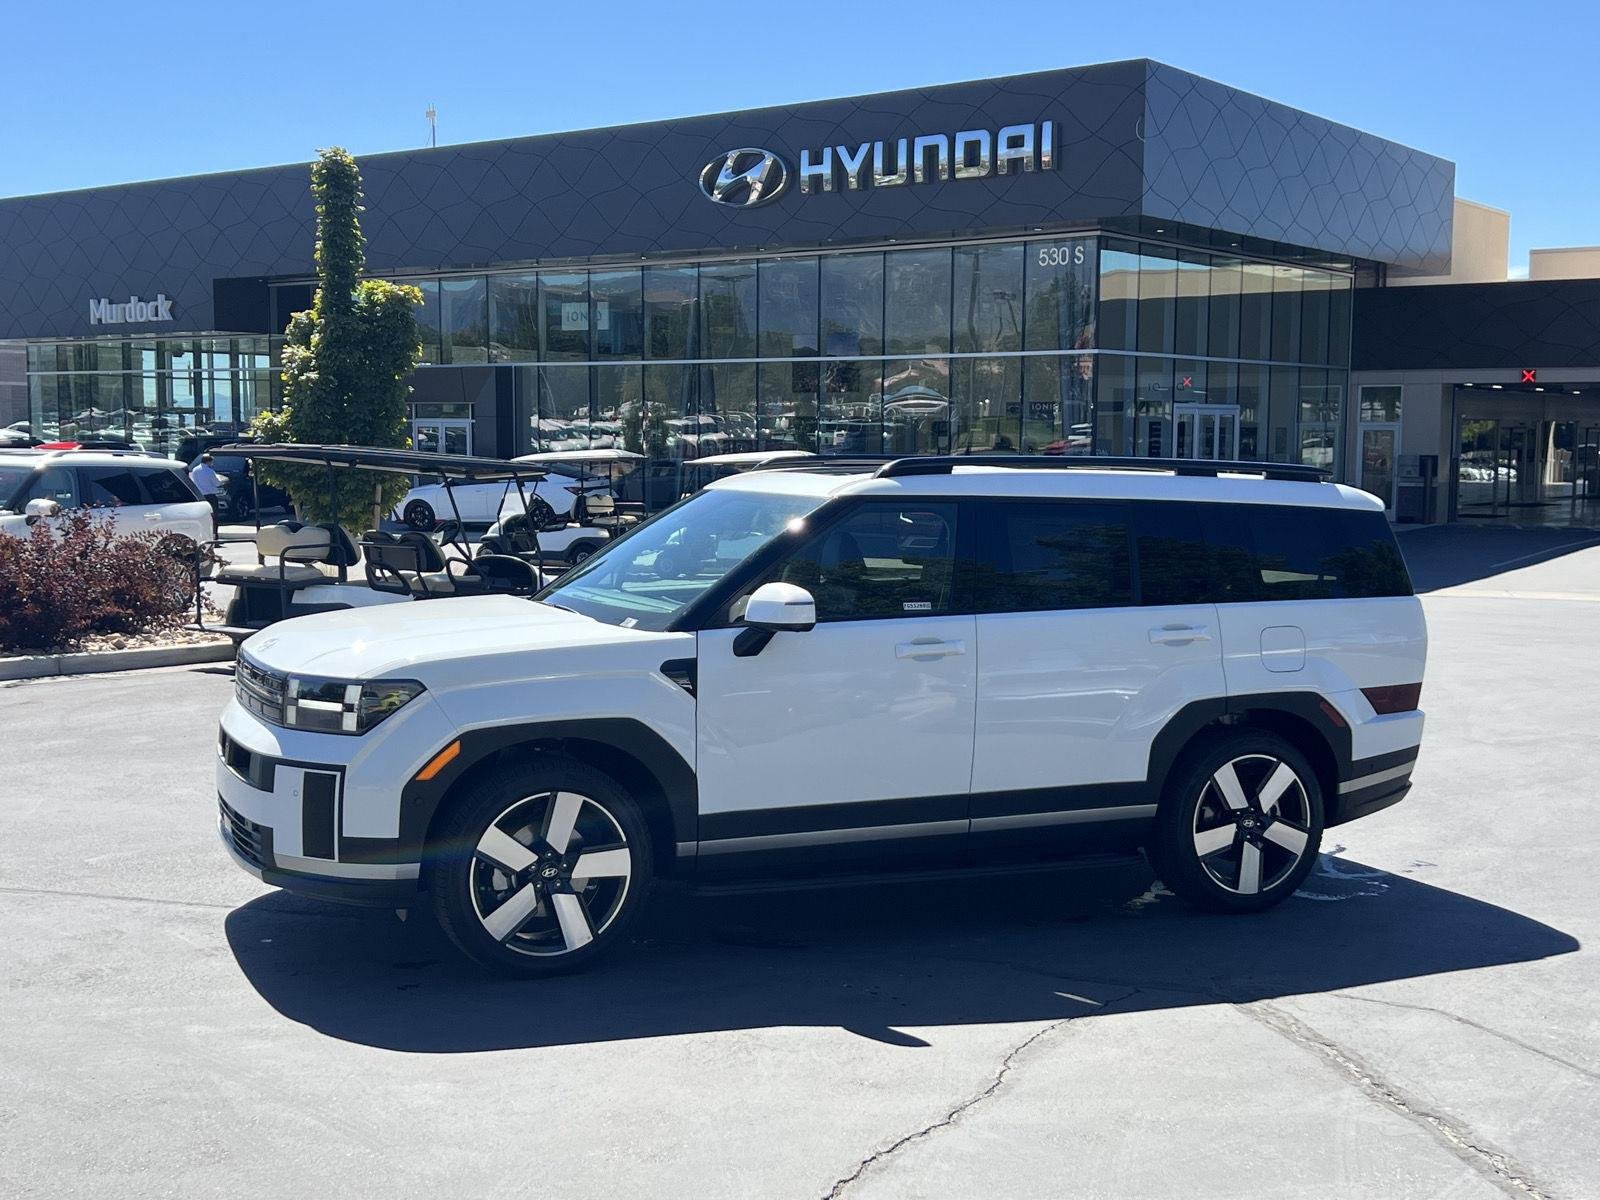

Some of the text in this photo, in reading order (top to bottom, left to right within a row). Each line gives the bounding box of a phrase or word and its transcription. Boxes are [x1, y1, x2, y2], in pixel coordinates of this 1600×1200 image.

[799, 120, 1055, 194] HYUNDAI
[1038, 245, 1084, 267] 530 S
[89, 293, 174, 325] Murdock
